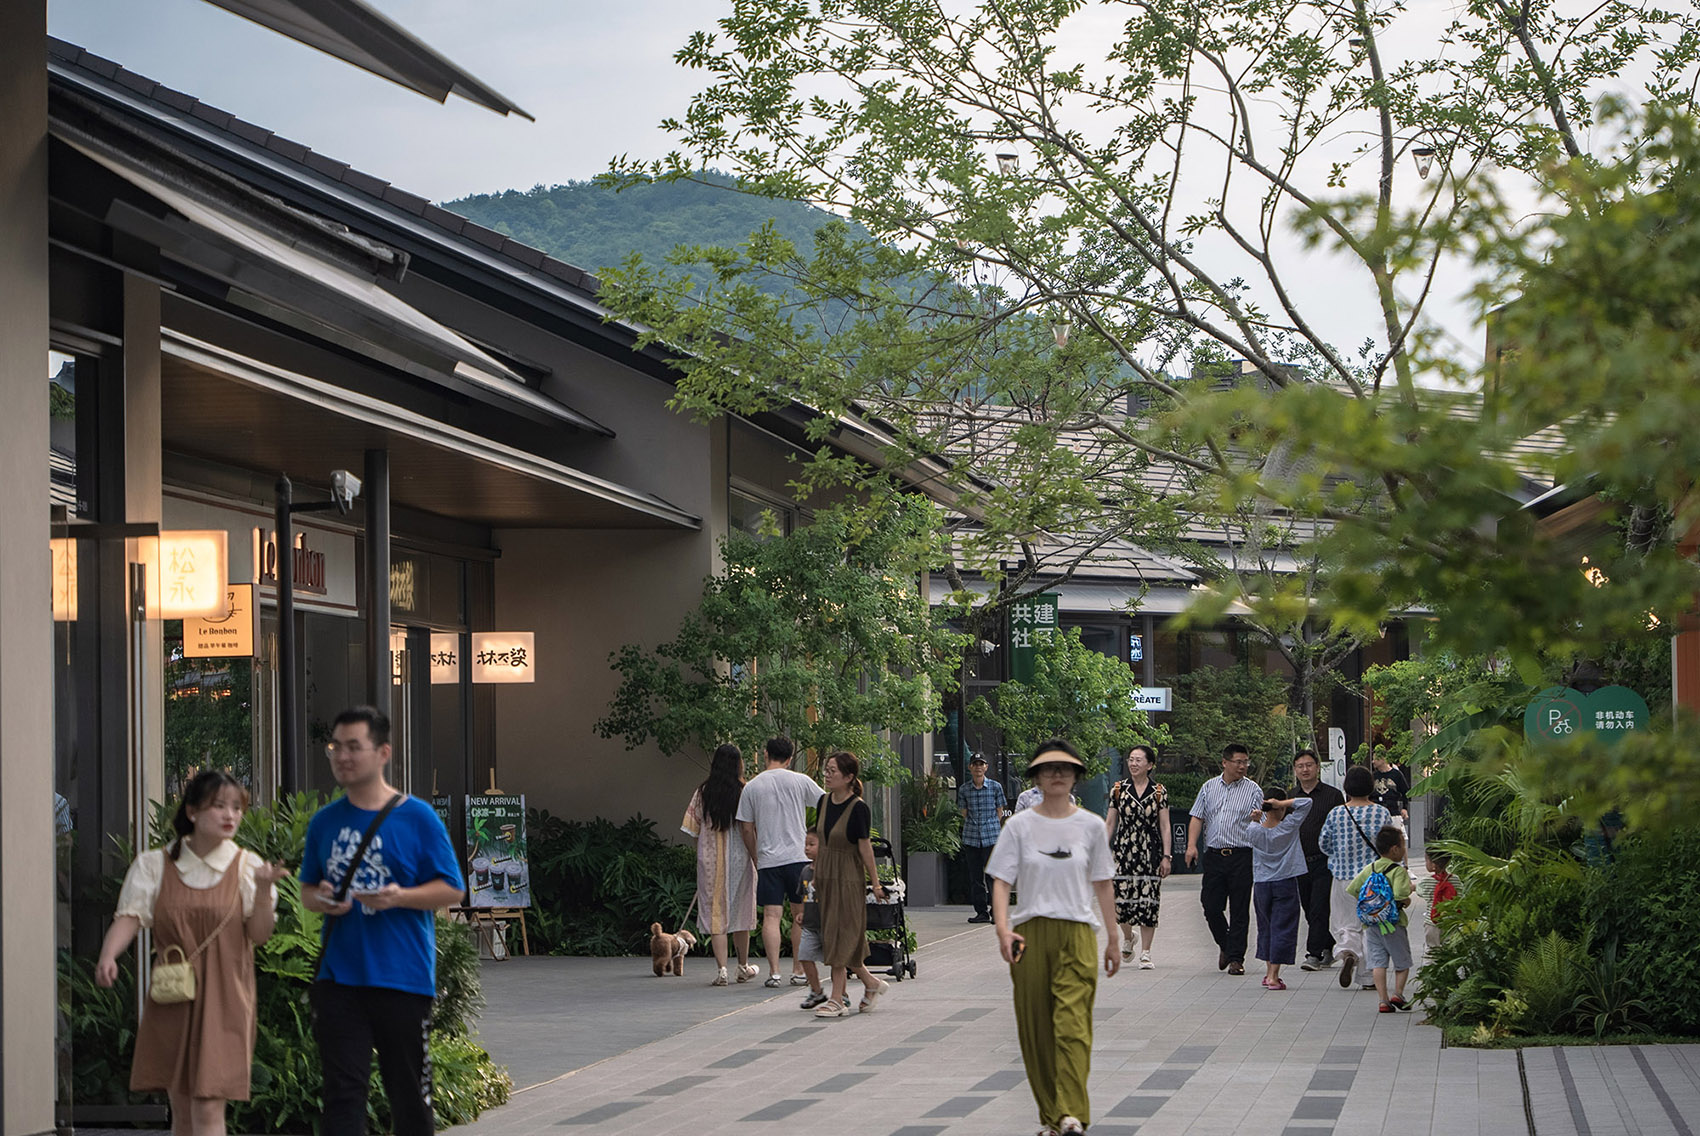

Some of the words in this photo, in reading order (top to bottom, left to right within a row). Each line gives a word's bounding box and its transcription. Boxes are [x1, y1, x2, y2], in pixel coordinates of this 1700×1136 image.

[1011, 603, 1055, 625] 共建
[1595, 711, 1635, 720] 非机动车
[1595, 720, 1635, 730] 请勿入内
[470, 797, 488, 805] NEW
[489, 797, 521, 805] ARRIVAL
